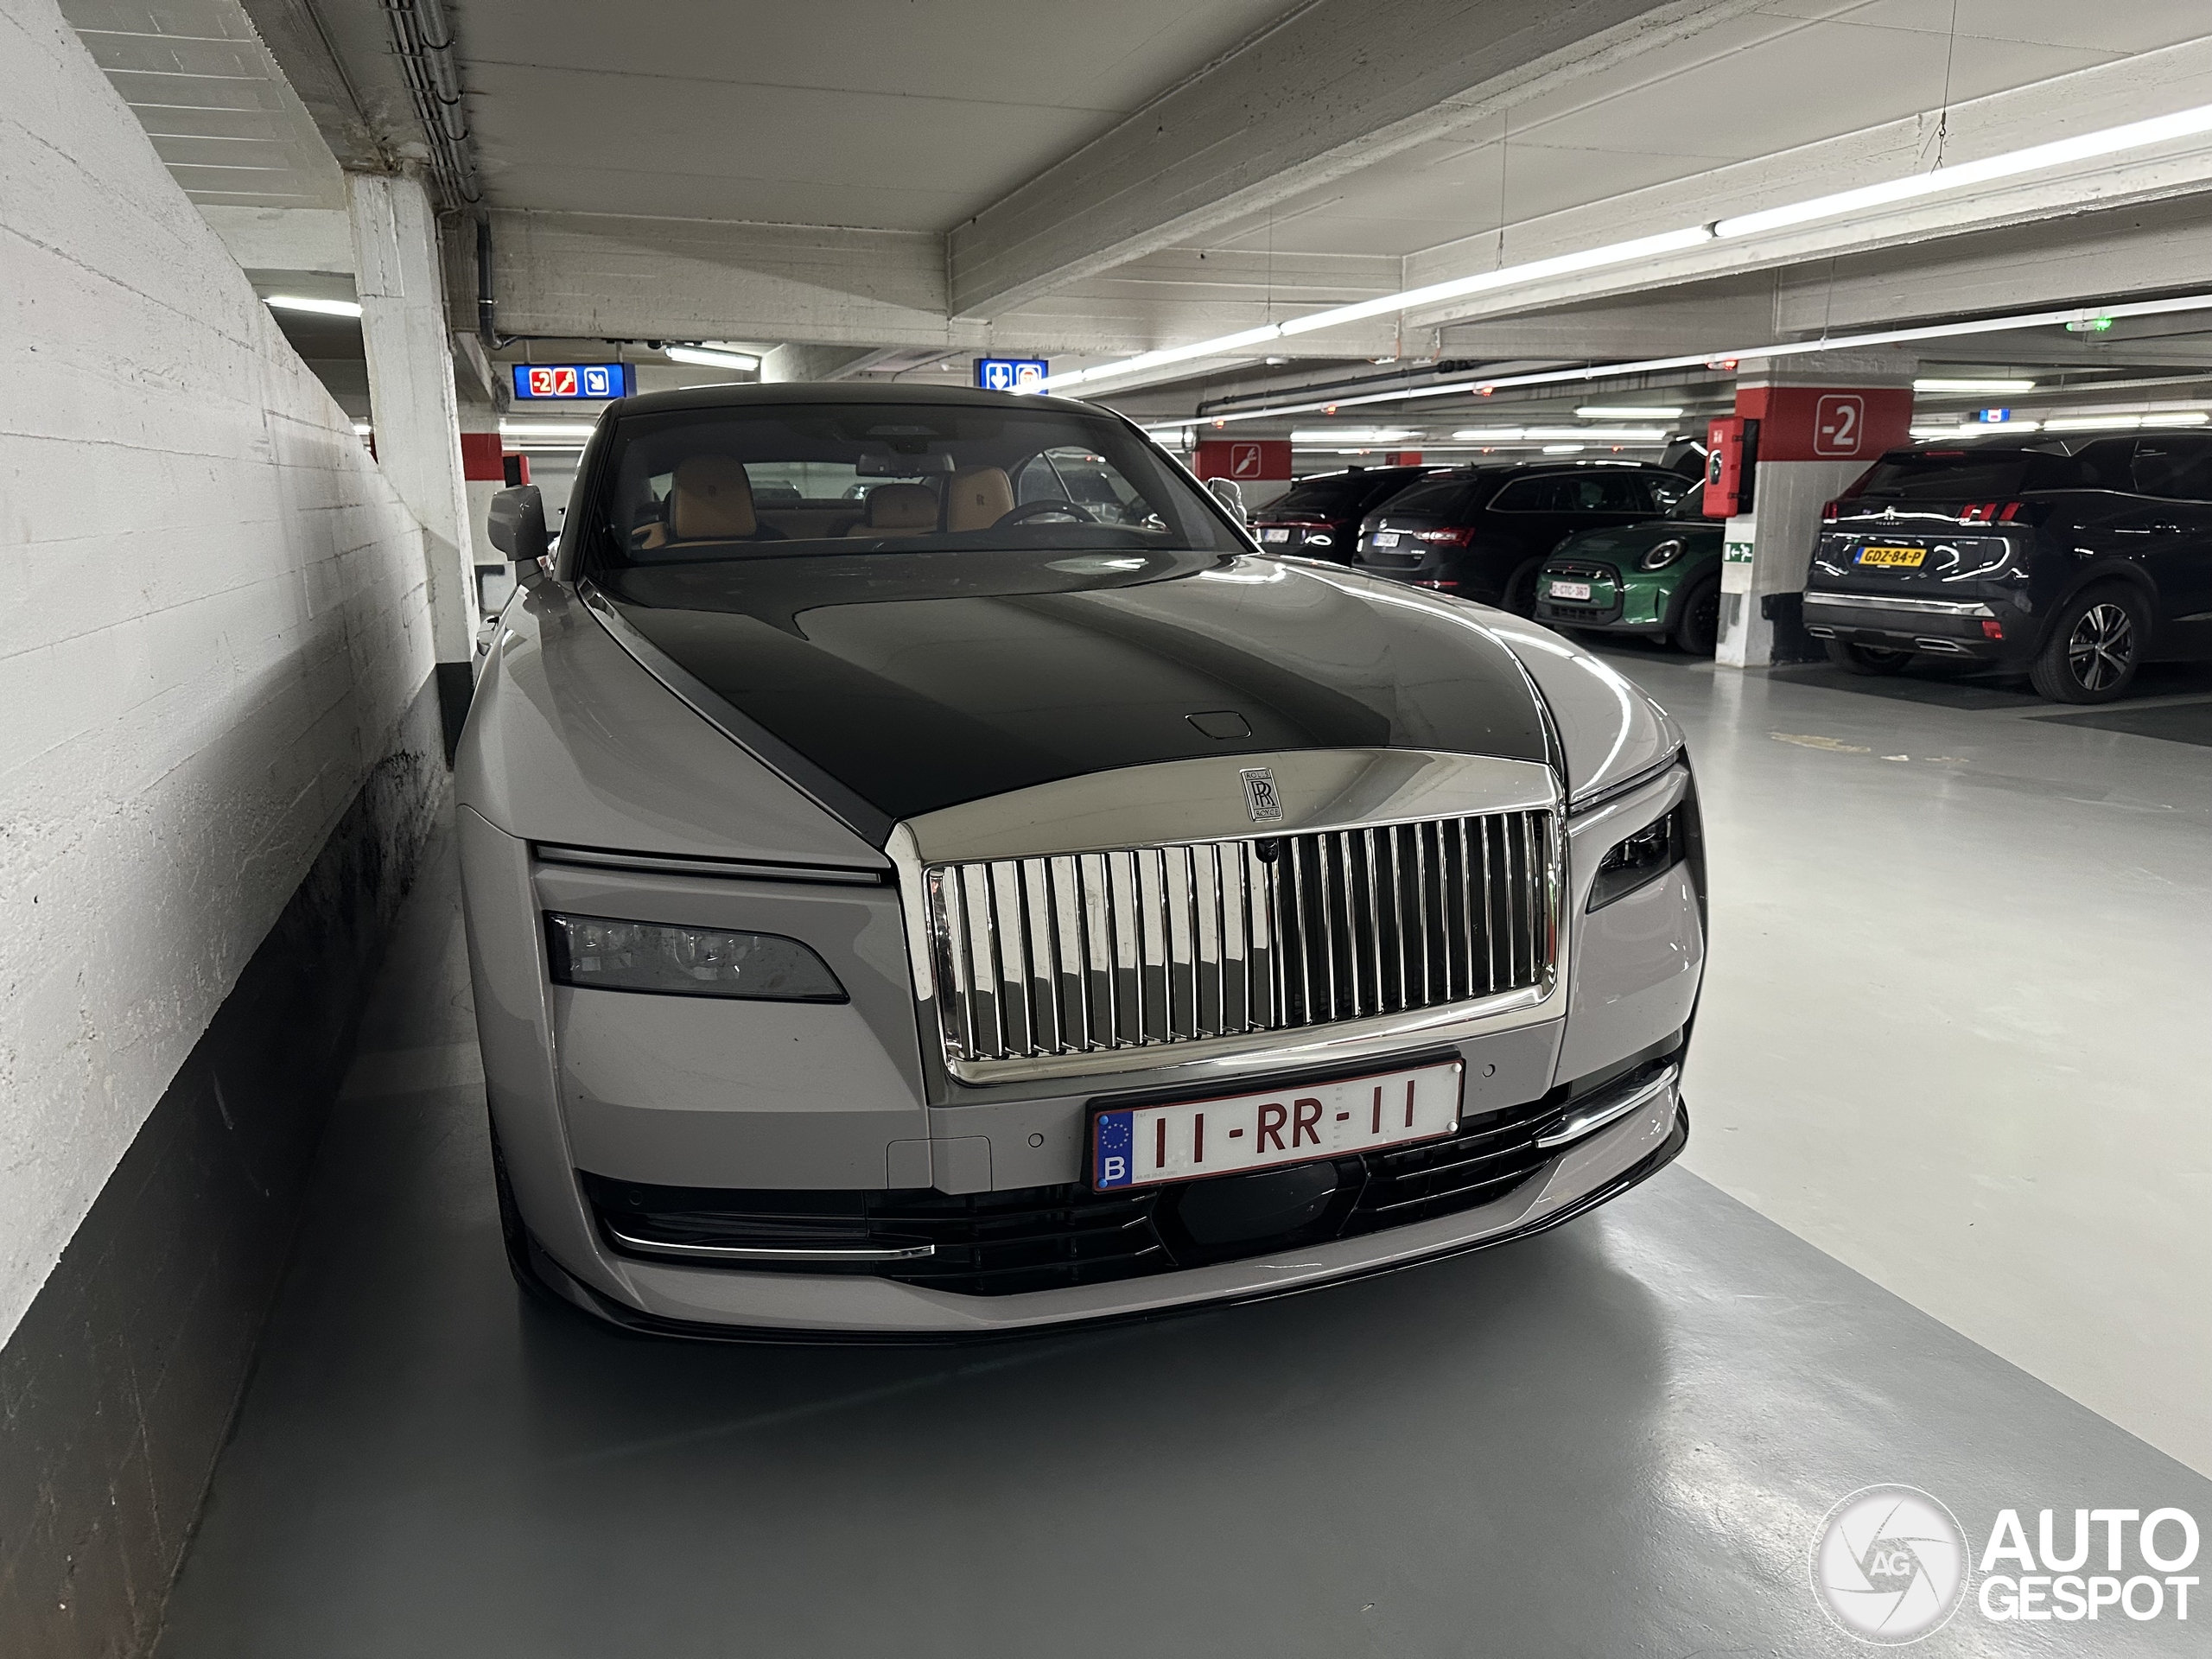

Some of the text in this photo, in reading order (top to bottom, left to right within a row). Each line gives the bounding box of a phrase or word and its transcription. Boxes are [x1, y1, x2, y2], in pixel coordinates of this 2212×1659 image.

[533, 372, 551, 391] -2
[1821, 405, 1856, 446] -2
[1865, 550, 1922, 564] GDZ-84-P
[1249, 780, 1276, 807] RR
[1104, 1156, 1126, 1181] B
